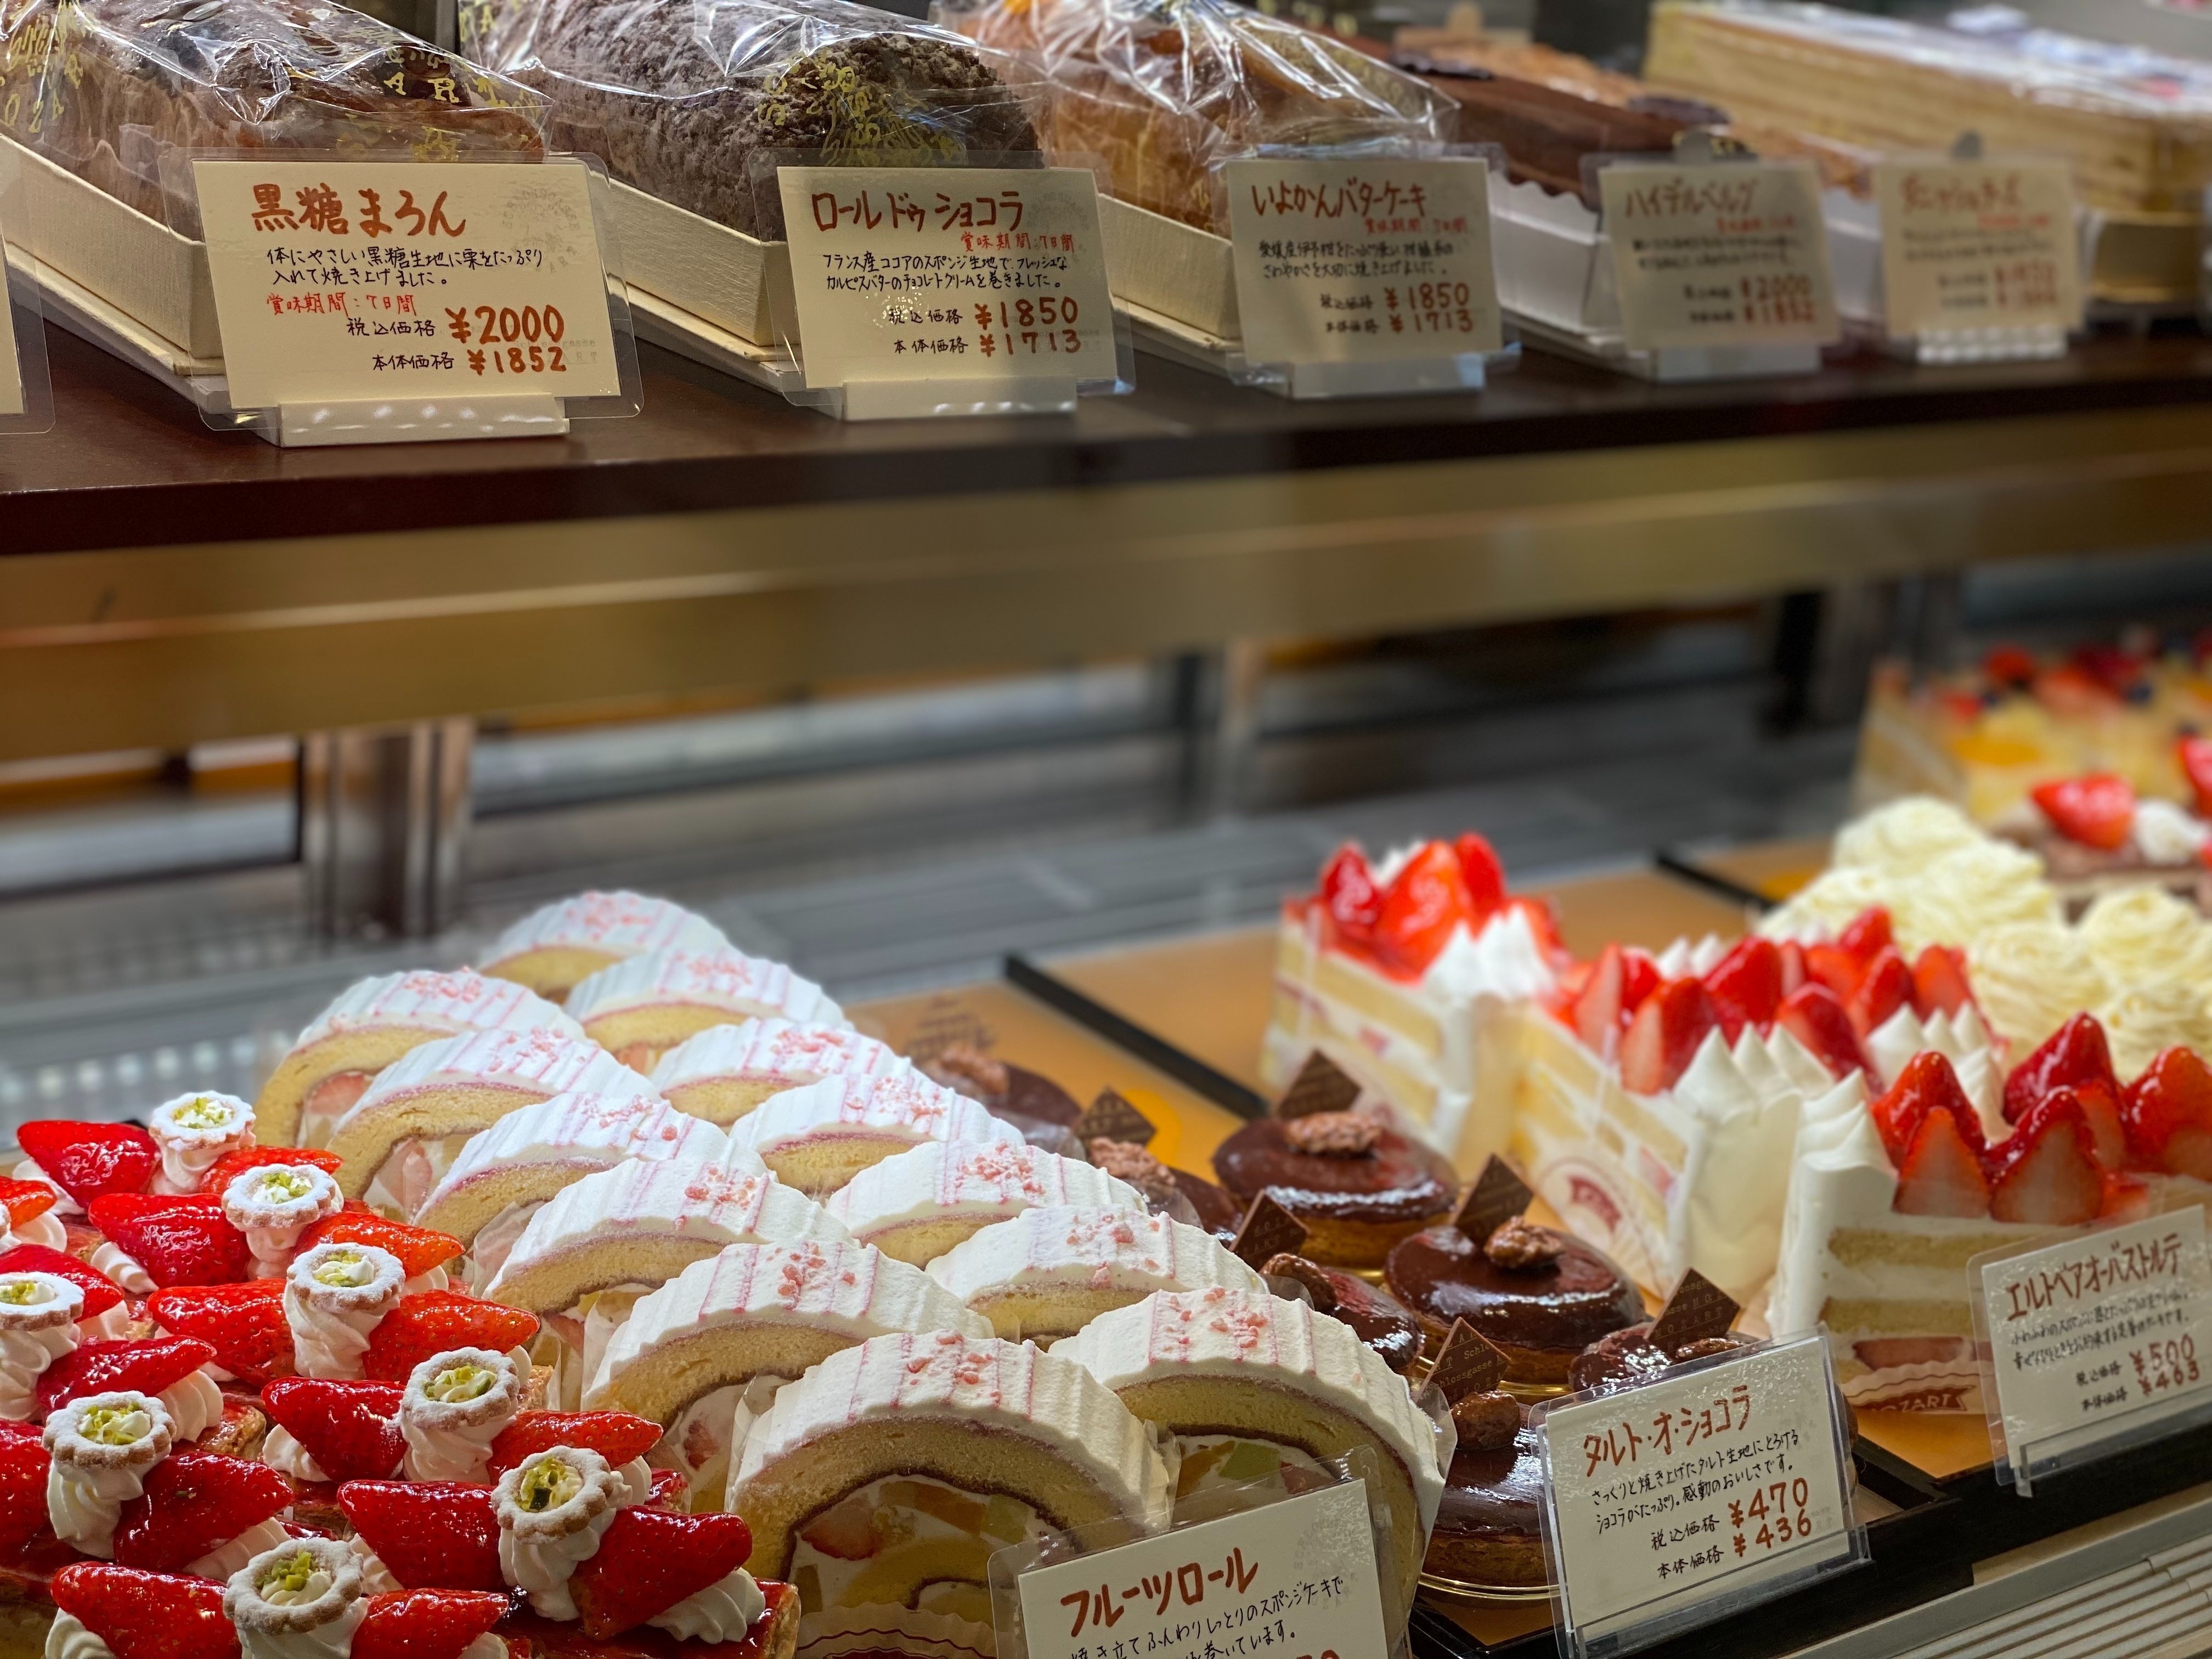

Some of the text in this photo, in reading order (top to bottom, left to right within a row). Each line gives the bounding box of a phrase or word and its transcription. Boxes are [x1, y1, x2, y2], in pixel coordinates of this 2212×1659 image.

[250, 182, 467, 237] 黒糖まろん
[1251, 177, 1426, 218] いよかんバターケーキ
[267, 246, 543, 269] 体にやさしい黒糖生地に栗をたっぷり
[273, 267, 448, 286] 入れて焼き上げました。
[826, 270, 1062, 292] カルピスバターのチョコレートクリームを巻きました。
[1384, 283, 1470, 311] ¥1850
[347, 304, 565, 344] 税込価格 ¥2000
[888, 296, 1078, 330] 税込価格 ¥1850
[1388, 309, 1474, 334] ¥1713
[373, 352, 455, 371] 本体価格
[467, 345, 567, 376] ¥1852
[894, 330, 1082, 358] 本体価格 ¥1713
[2129, 1333, 2194, 1375] ¥500
[2137, 1359, 2200, 1397] ¥463
[1592, 1429, 1799, 1505] さっくりと焼き上げたタルト生地にとろける
[1596, 1453, 1793, 1534] ショコラがたっぷり。感動のおいしさです。
[1651, 1515, 1720, 1549] 税込価格
[1728, 1477, 1808, 1528] ¥470
[1657, 1545, 1724, 1579] 本体価格
[1733, 1509, 1812, 1557] ¥436
[1060, 1547, 1259, 1638] フルーツロール
